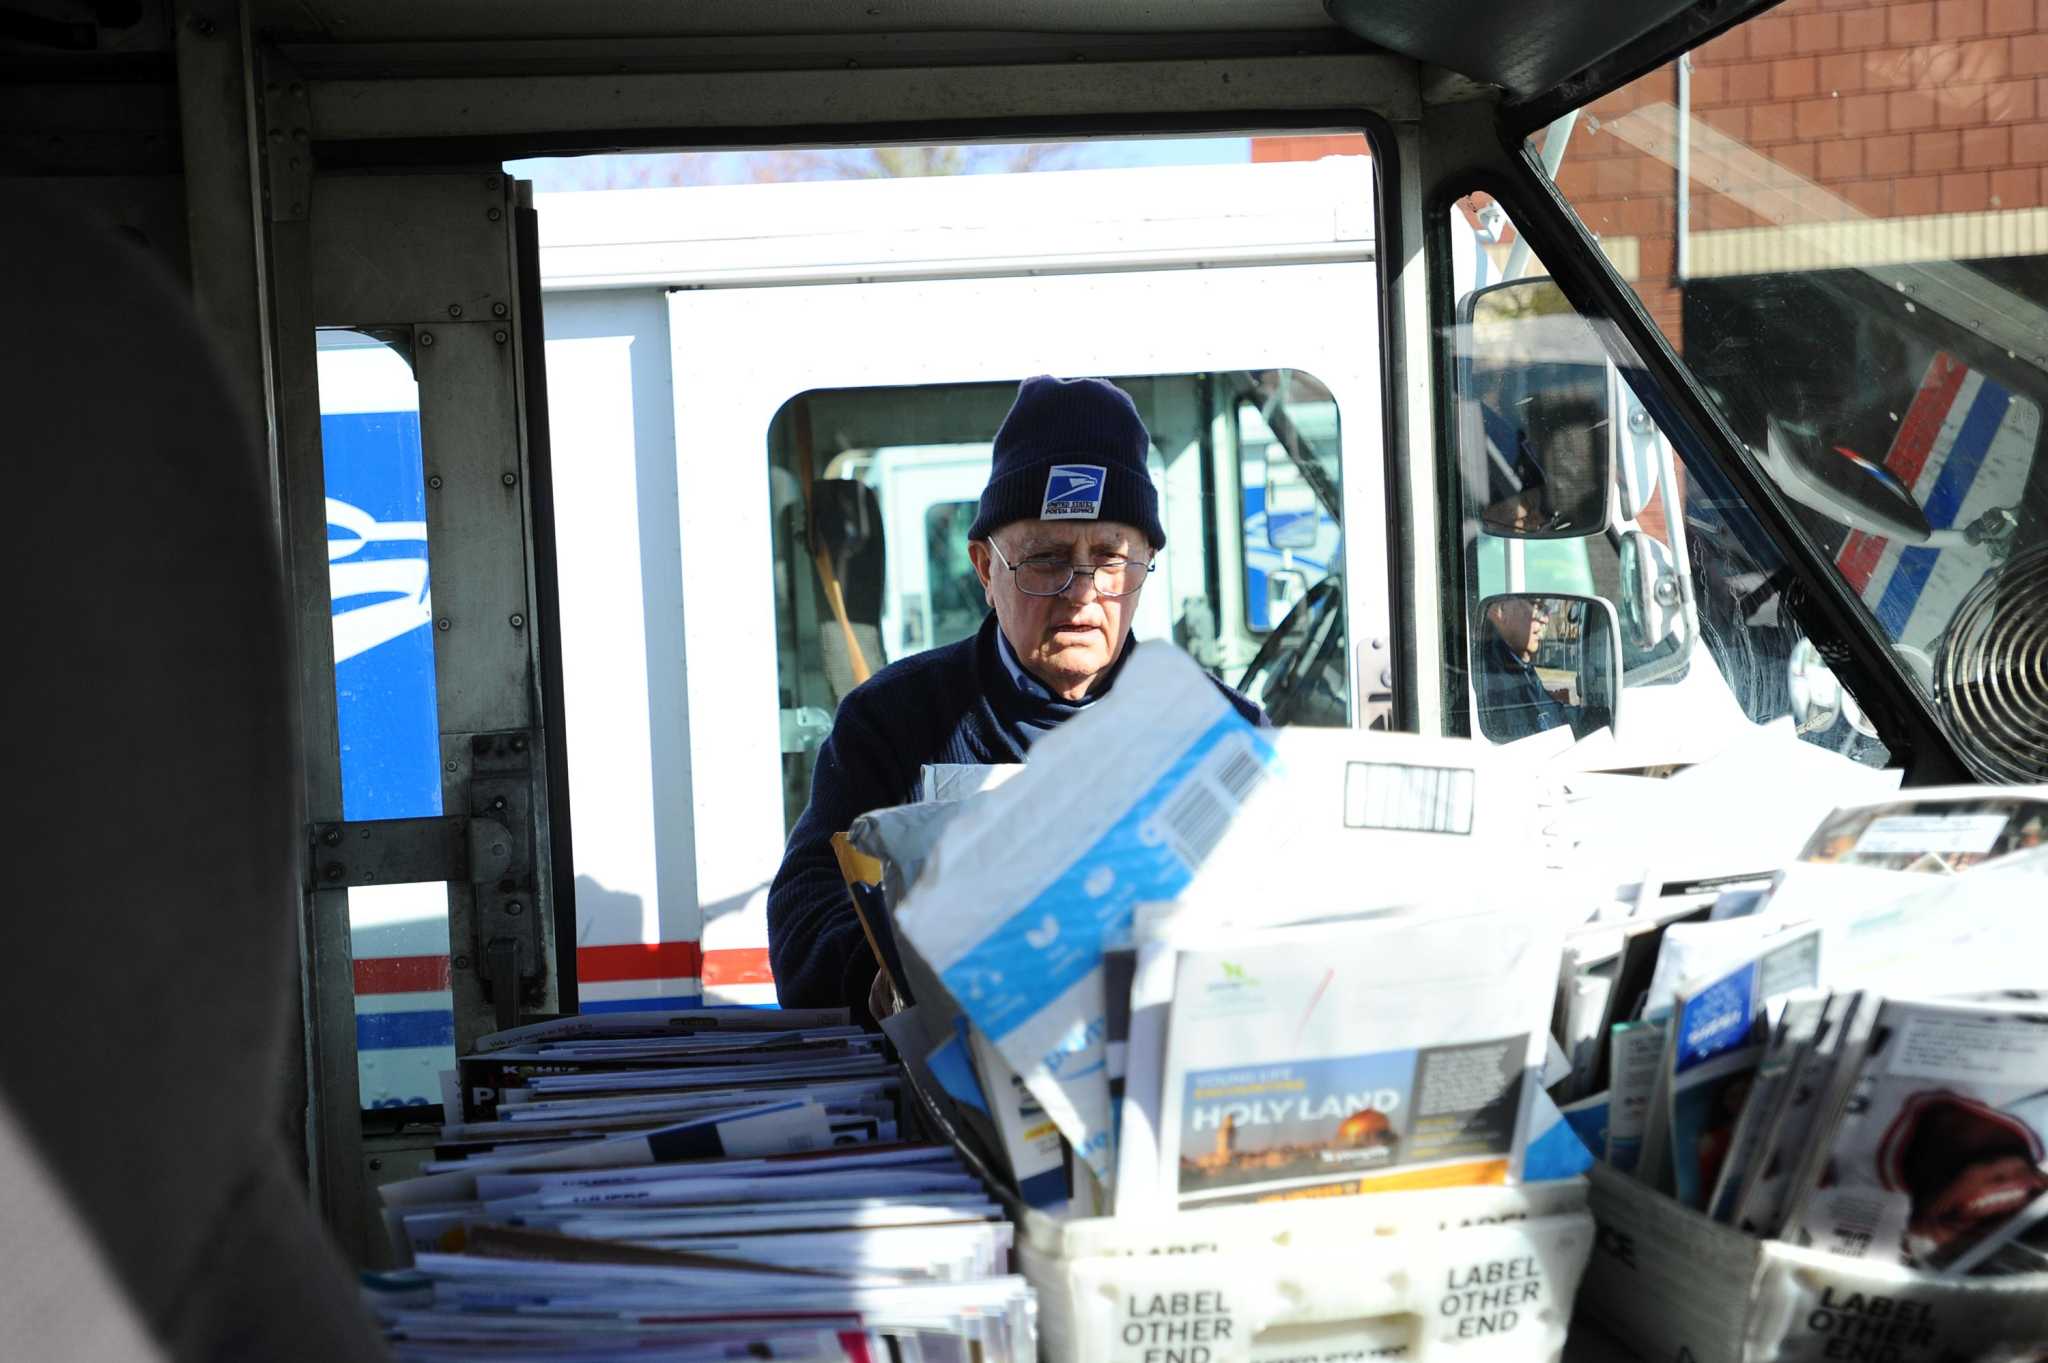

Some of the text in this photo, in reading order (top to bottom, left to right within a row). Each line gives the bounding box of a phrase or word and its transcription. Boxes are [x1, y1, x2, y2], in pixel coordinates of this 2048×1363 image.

[1193, 1098, 1294, 1132] HOLY
[1300, 1088, 1401, 1121] LAND
[1447, 1255, 1541, 1289] LABEL
[1128, 1291, 1231, 1318] LABEL
[1440, 1281, 1541, 1316] OTHER
[1820, 1286, 1935, 1322] LABEL
[1122, 1318, 1233, 1345] OTHER
[1458, 1309, 1519, 1338] END
[1808, 1309, 1936, 1346] OTHER
[1144, 1346, 1211, 1363] END
